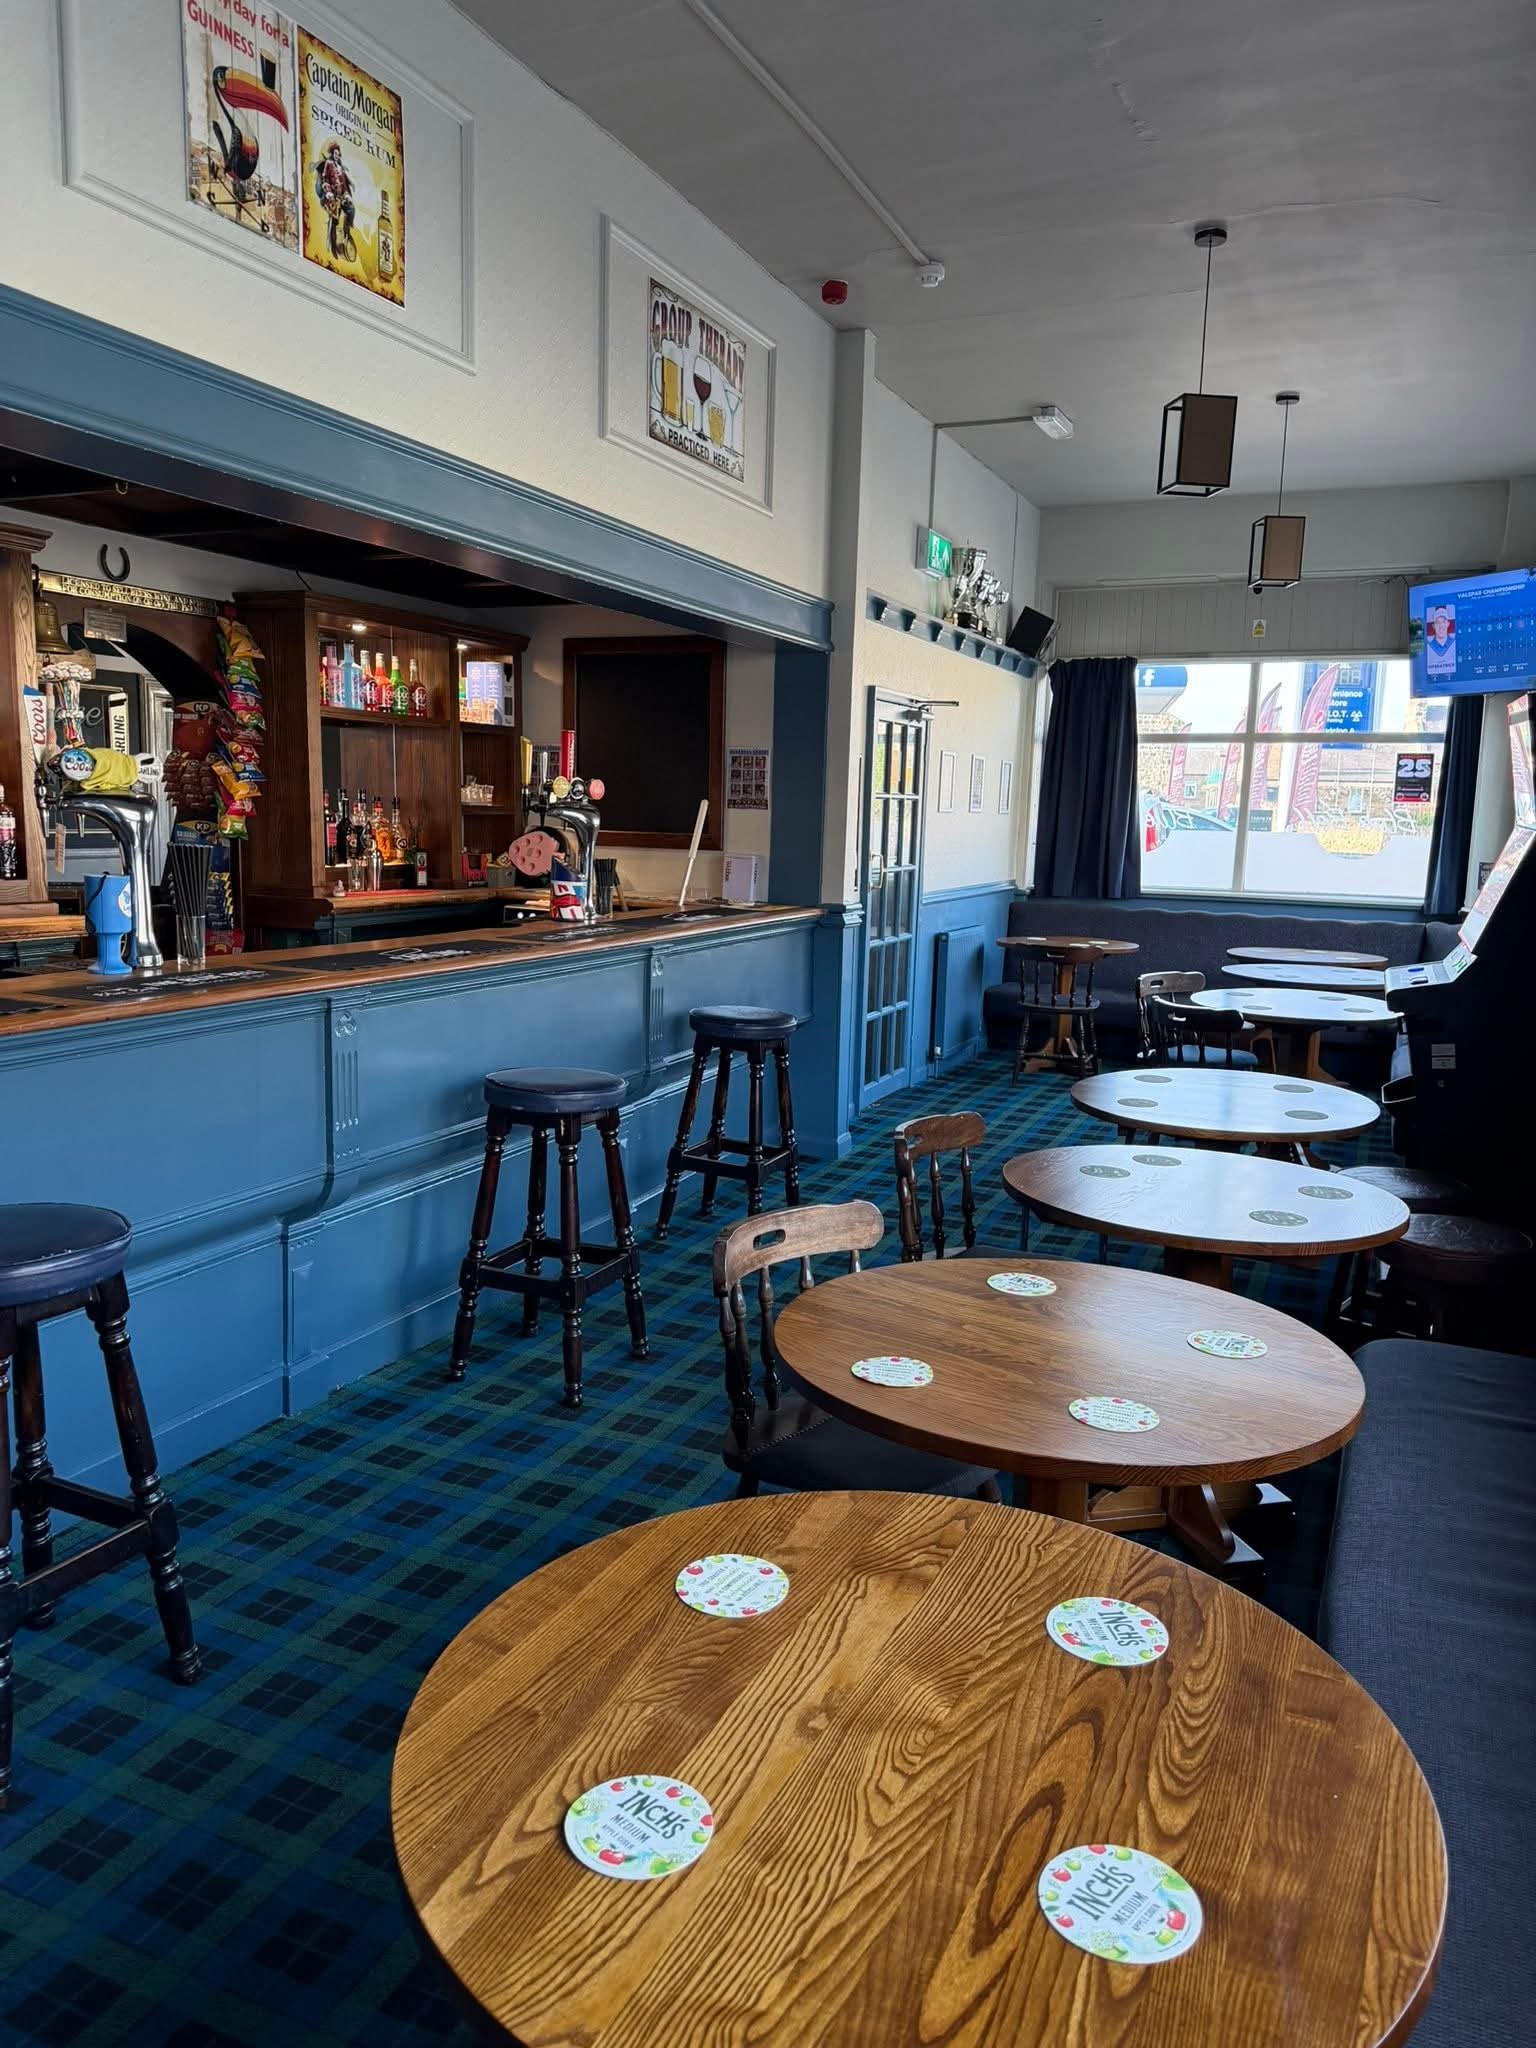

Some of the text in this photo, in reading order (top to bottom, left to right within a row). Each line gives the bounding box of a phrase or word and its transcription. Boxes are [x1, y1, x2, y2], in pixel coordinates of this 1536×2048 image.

[187, 0, 254, 58] GUINNESS
[260, 15, 280, 39] for
[281, 33, 290, 48] a
[305, 52, 397, 137] Captain Morgan
[335, 103, 371, 134] ORIGINAL
[311, 104, 396, 168] SPICED RUM
[650, 300, 745, 394] GROUP THERAPY
[668, 428, 730, 472] PRACTICED HERE
[63, 576, 101, 592] LICENSED
[102, 583, 112, 593] TO
[112, 585, 129, 595] SELL
[80, 587, 131, 602] CONSUMPTION
[1483, 583, 1526, 596] CHAMPIONSHIP
[31, 699, 46, 745] Coors
[194, 703, 210, 712] KP
[113, 713, 126, 755] ARLING
[138, 766, 159, 777] ARLING
[1397, 758, 1432, 778] 25
[196, 822, 210, 831] KP
[1098, 1610, 1146, 1647] INCH'S
[611, 1813, 652, 1844] MEDIUM
[616, 1789, 691, 1840] INCH'S
[601, 1823, 620, 1841] APPLE
[1066, 1861, 1136, 1921] INCH'S
[1111, 1890, 1150, 1925] MEDIUM
[1131, 1913, 1151, 1932] APPLE
